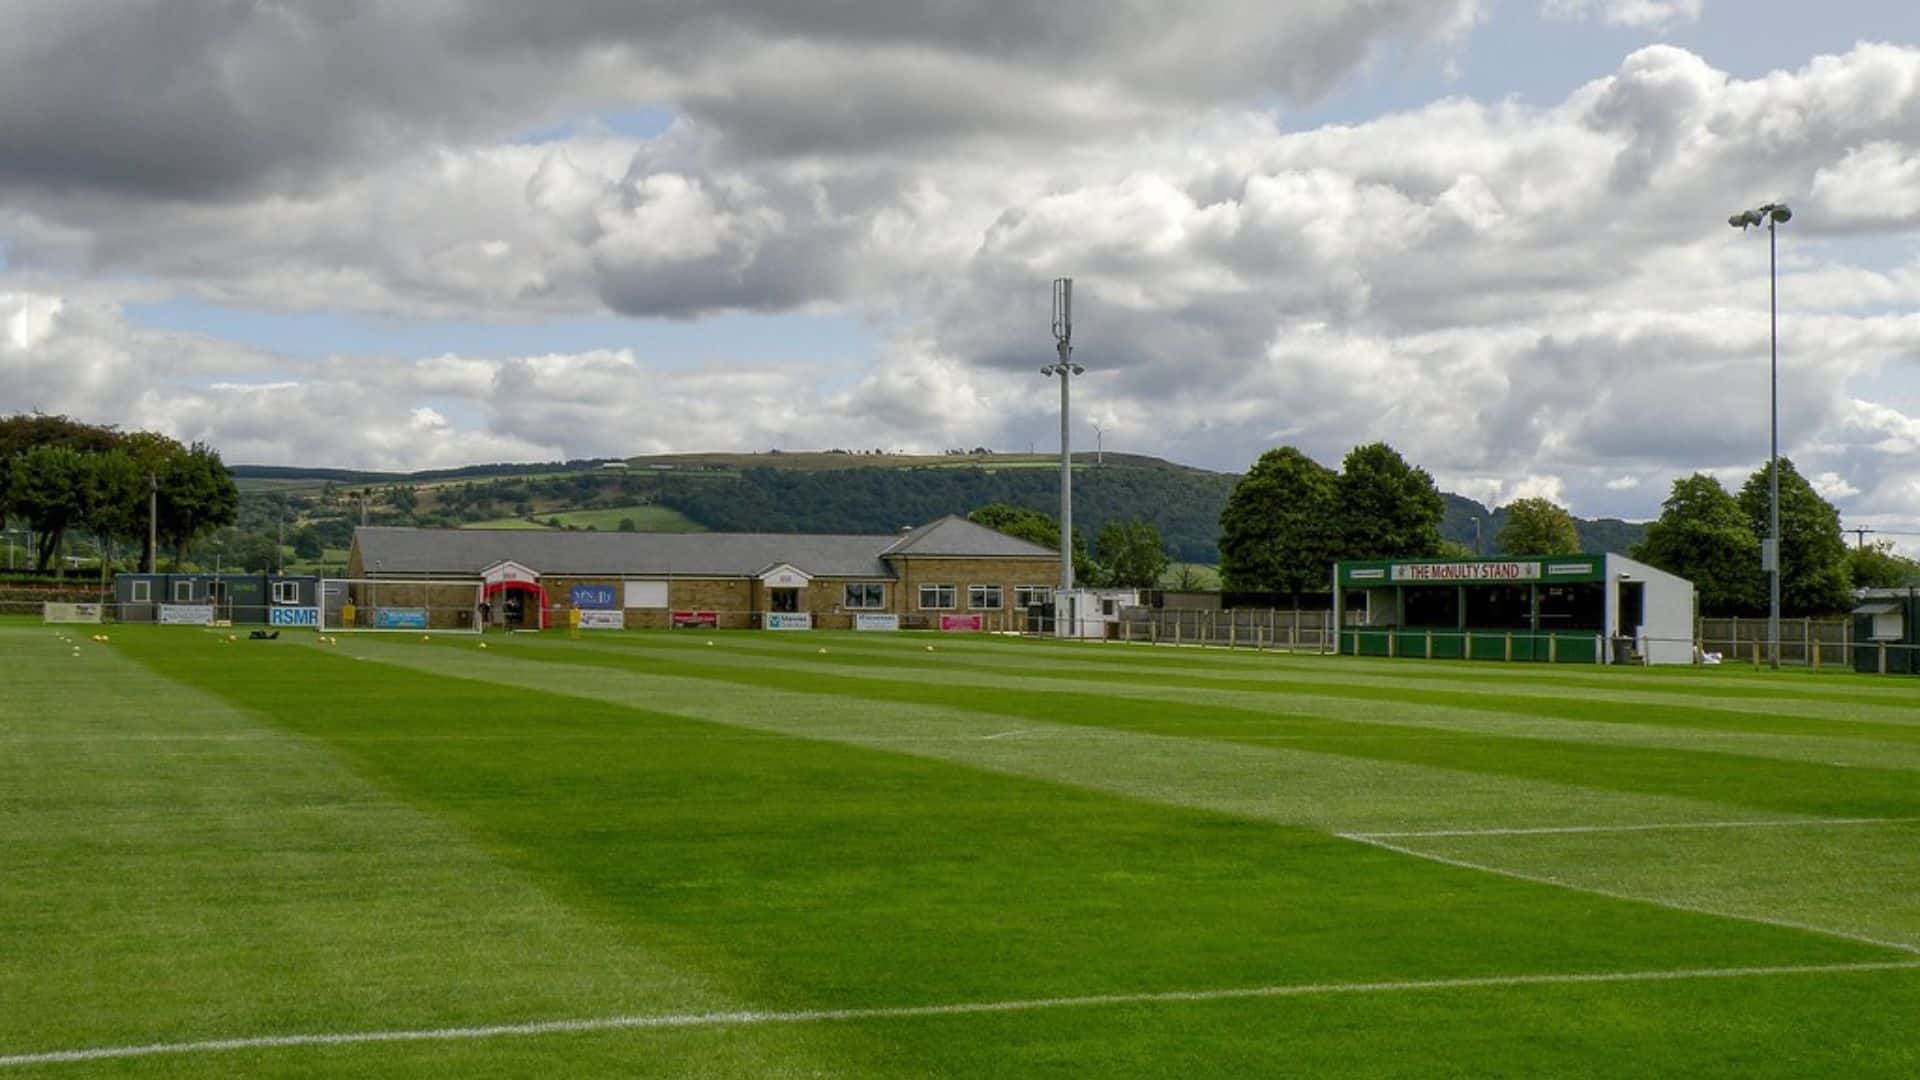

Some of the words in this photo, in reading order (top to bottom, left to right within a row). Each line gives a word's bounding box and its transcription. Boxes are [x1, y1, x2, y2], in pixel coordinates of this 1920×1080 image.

[1410, 565, 1430, 578] THE
[1432, 564, 1481, 578] McNULTY
[1481, 563, 1520, 578] STAND
[273, 608, 319, 625] RSMR
